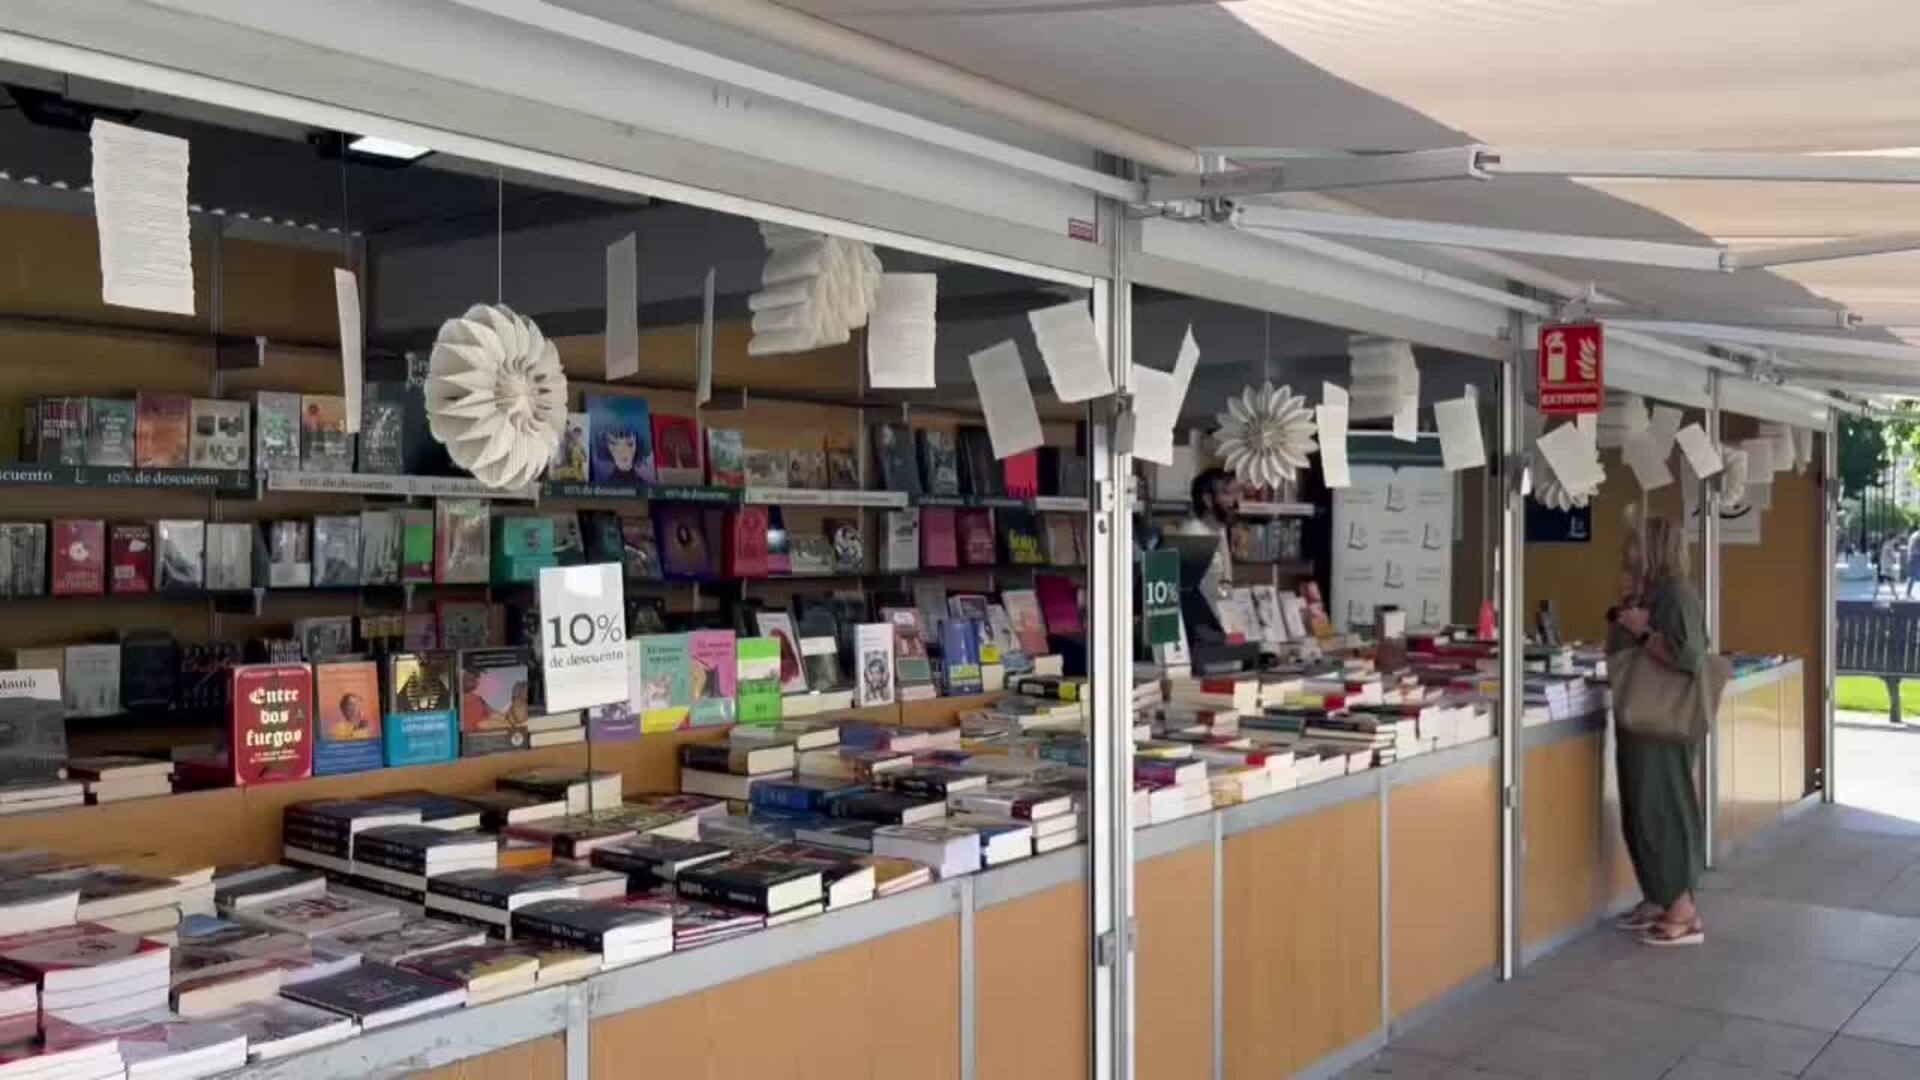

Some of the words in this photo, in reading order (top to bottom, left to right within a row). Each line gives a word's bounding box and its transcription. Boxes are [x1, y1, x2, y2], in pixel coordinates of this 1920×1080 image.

[1542, 393, 1597, 406] EXTINTOR
[107, 472, 132, 483] 10%
[135, 470, 151, 484] de
[153, 471, 219, 486] descuento
[1147, 580, 1177, 604] 10%
[548, 612, 623, 649] 10%
[549, 653, 564, 669] de
[567, 650, 624, 667] descuento
[249, 687, 299, 704] Entre
